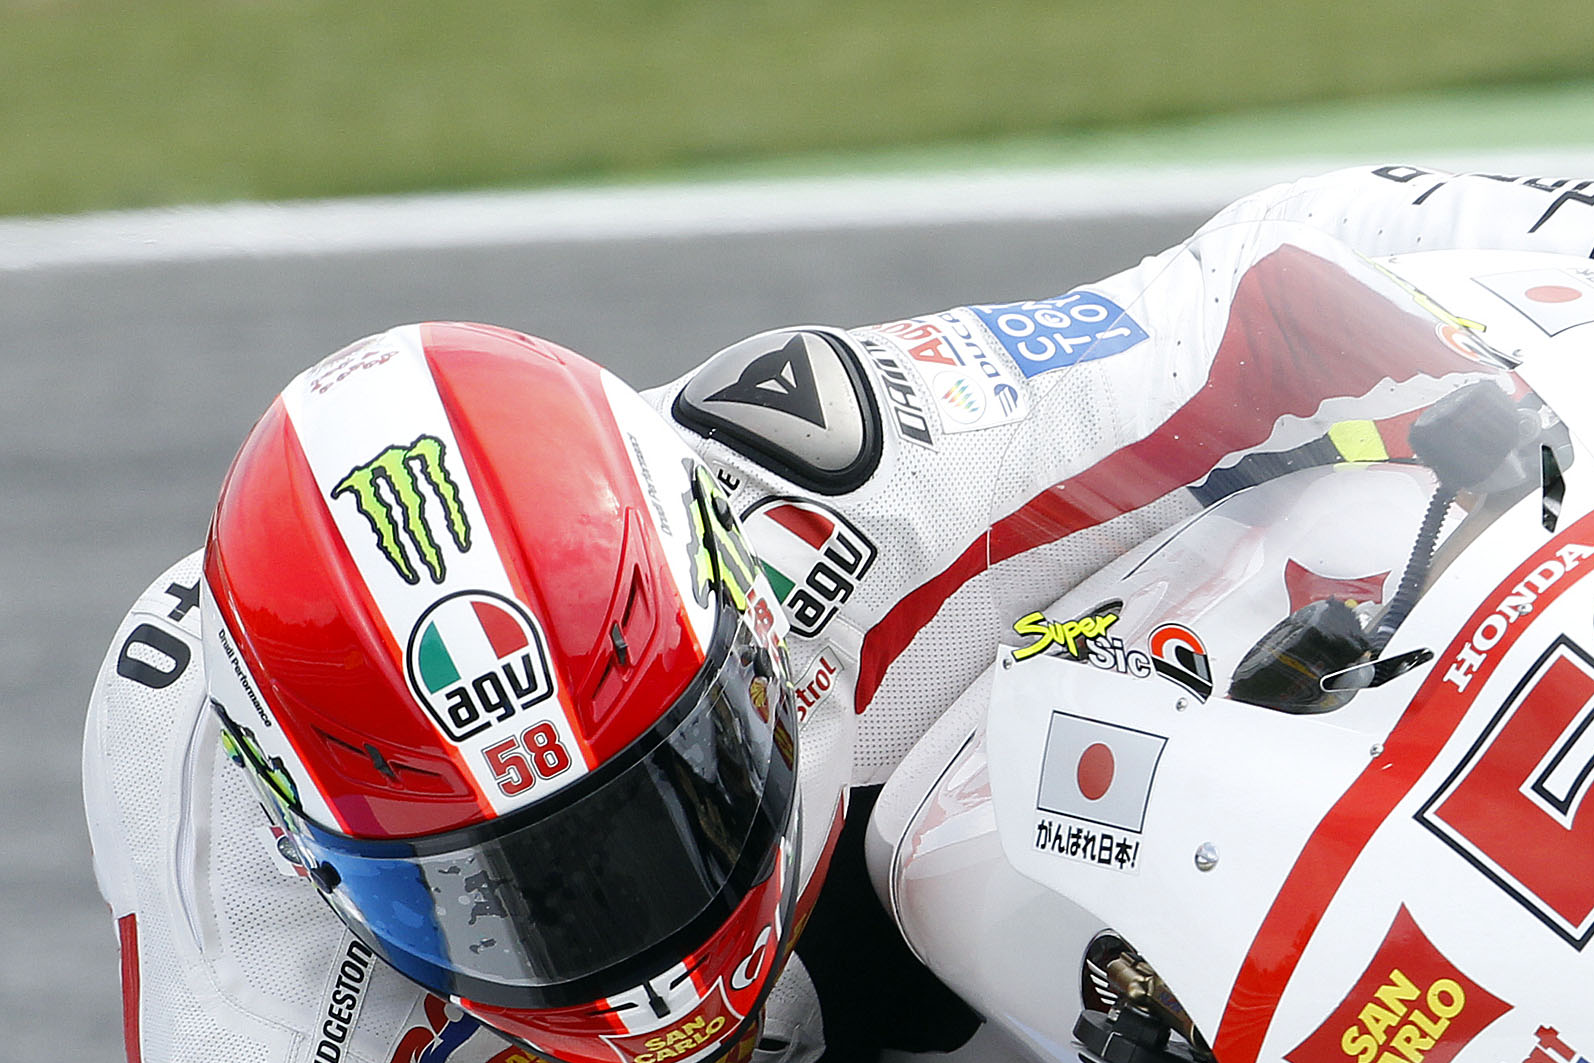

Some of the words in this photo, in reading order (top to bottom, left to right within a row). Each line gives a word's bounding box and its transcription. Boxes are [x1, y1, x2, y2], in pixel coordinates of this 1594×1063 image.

[787, 531, 863, 628] agv
[1011, 611, 1120, 663] Super
[1085, 636, 1152, 679] Sic
[231, 656, 272, 728] Performance
[444, 652, 539, 730] agv
[796, 655, 837, 722] strol
[480, 719, 573, 798] 58
[1035, 818, 1140, 870] がんばれ日本!
[643, 1015, 706, 1052] SAN
